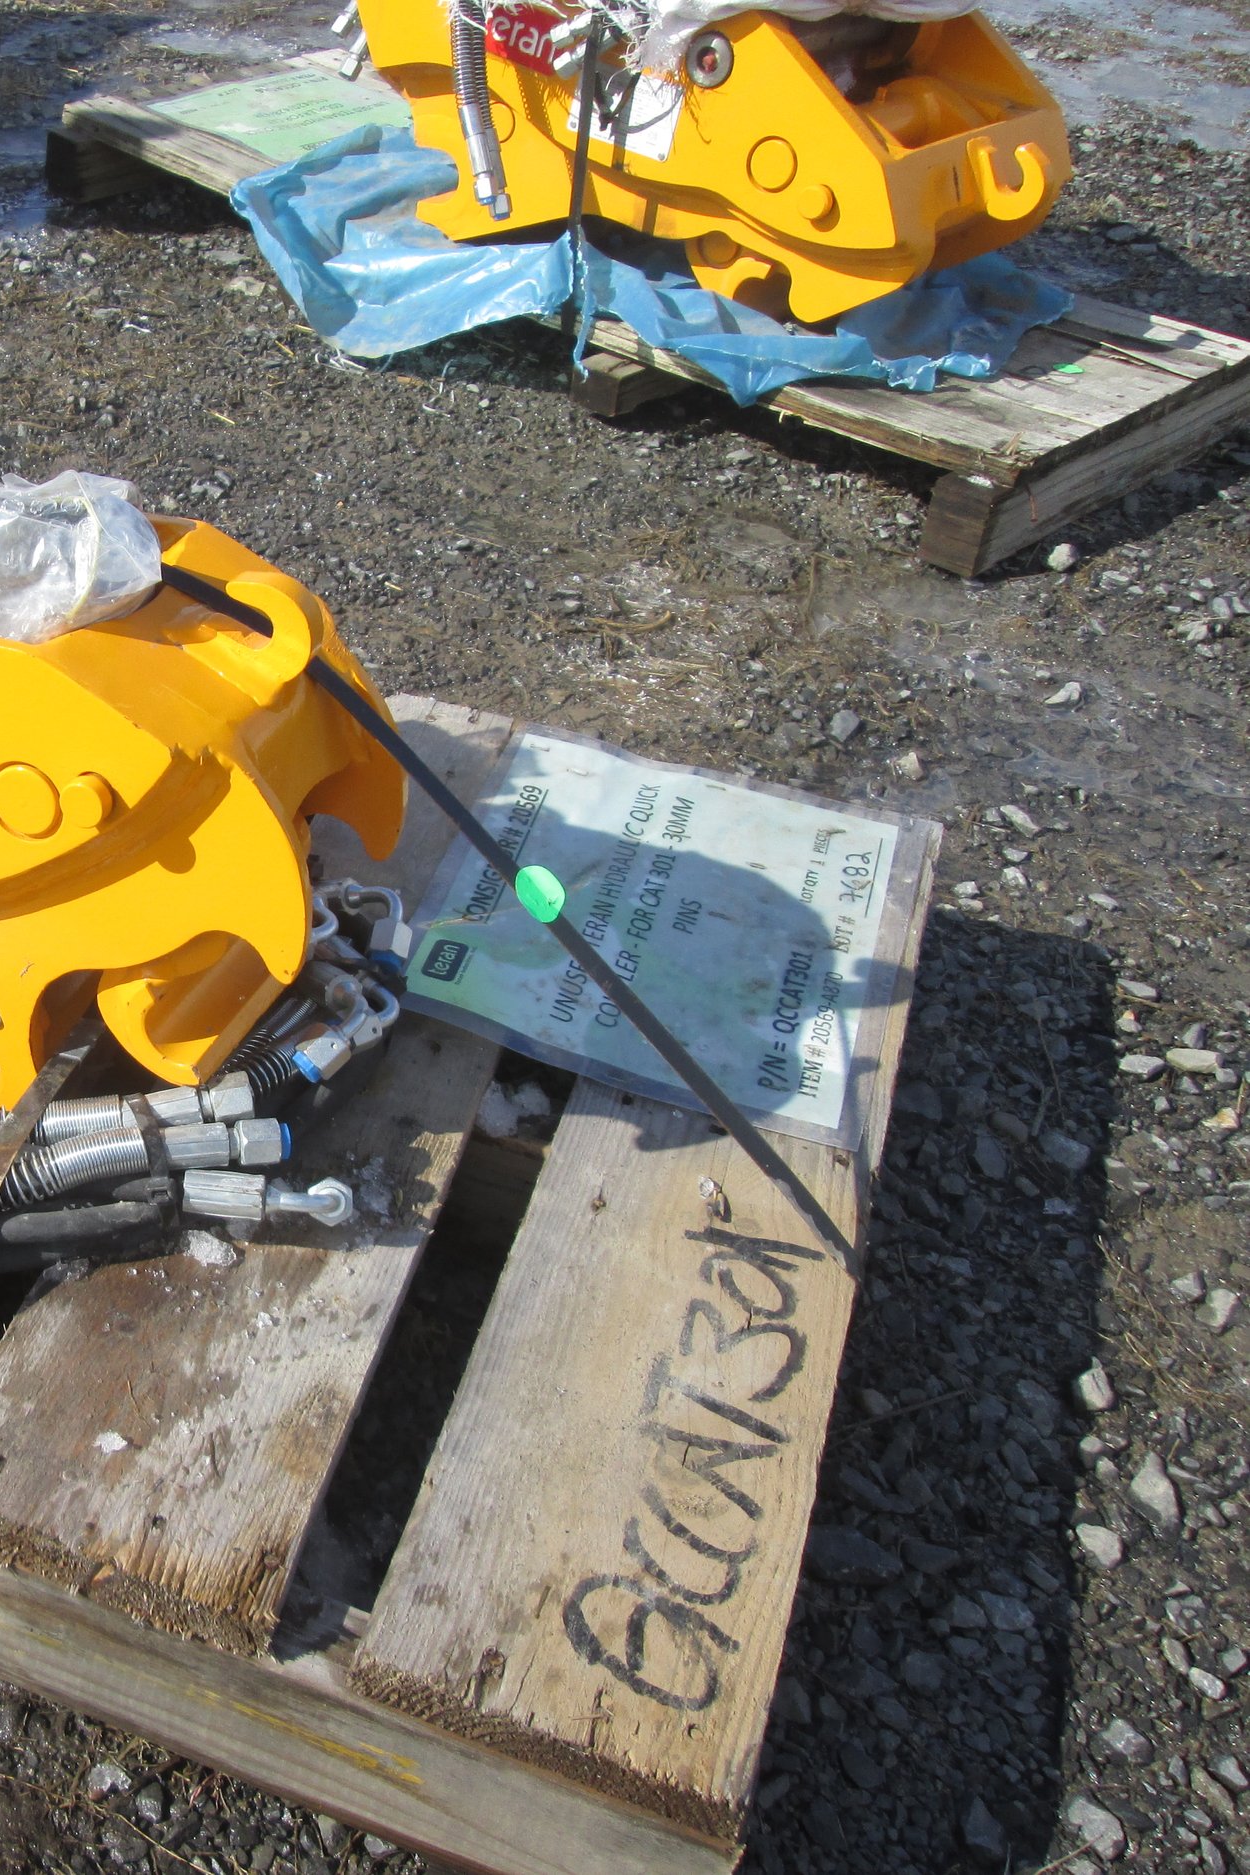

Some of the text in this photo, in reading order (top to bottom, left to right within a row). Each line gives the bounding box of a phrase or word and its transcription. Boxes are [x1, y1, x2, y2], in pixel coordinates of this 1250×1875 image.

[491, 15, 556, 64] eran
[663, 795, 695, 843] 30MM
[462, 836, 518, 925] CONSIGR
[513, 783, 543, 826] 20569
[812, 828, 829, 854] PIECES
[650, 850, 676, 879] 301
[803, 869, 820, 887] QTY
[550, 951, 595, 1024] UNUSE
[599, 821, 646, 900] HYDRAULIC
[630, 780, 663, 823] QUICK
[639, 878, 666, 908] CAT
[799, 886, 814, 904] LOT
[627, 907, 656, 940] FOR
[673, 896, 703, 934] PINS
[832, 924, 853, 954] LOT
[434, 941, 460, 977] teran
[594, 949, 641, 1029] COLER
[755, 1051, 789, 1092] P/N
[772, 948, 816, 1036] QCCAT301
[798, 1058, 823, 1098] ITEM
[812, 969, 843, 1045] 20569-A870
